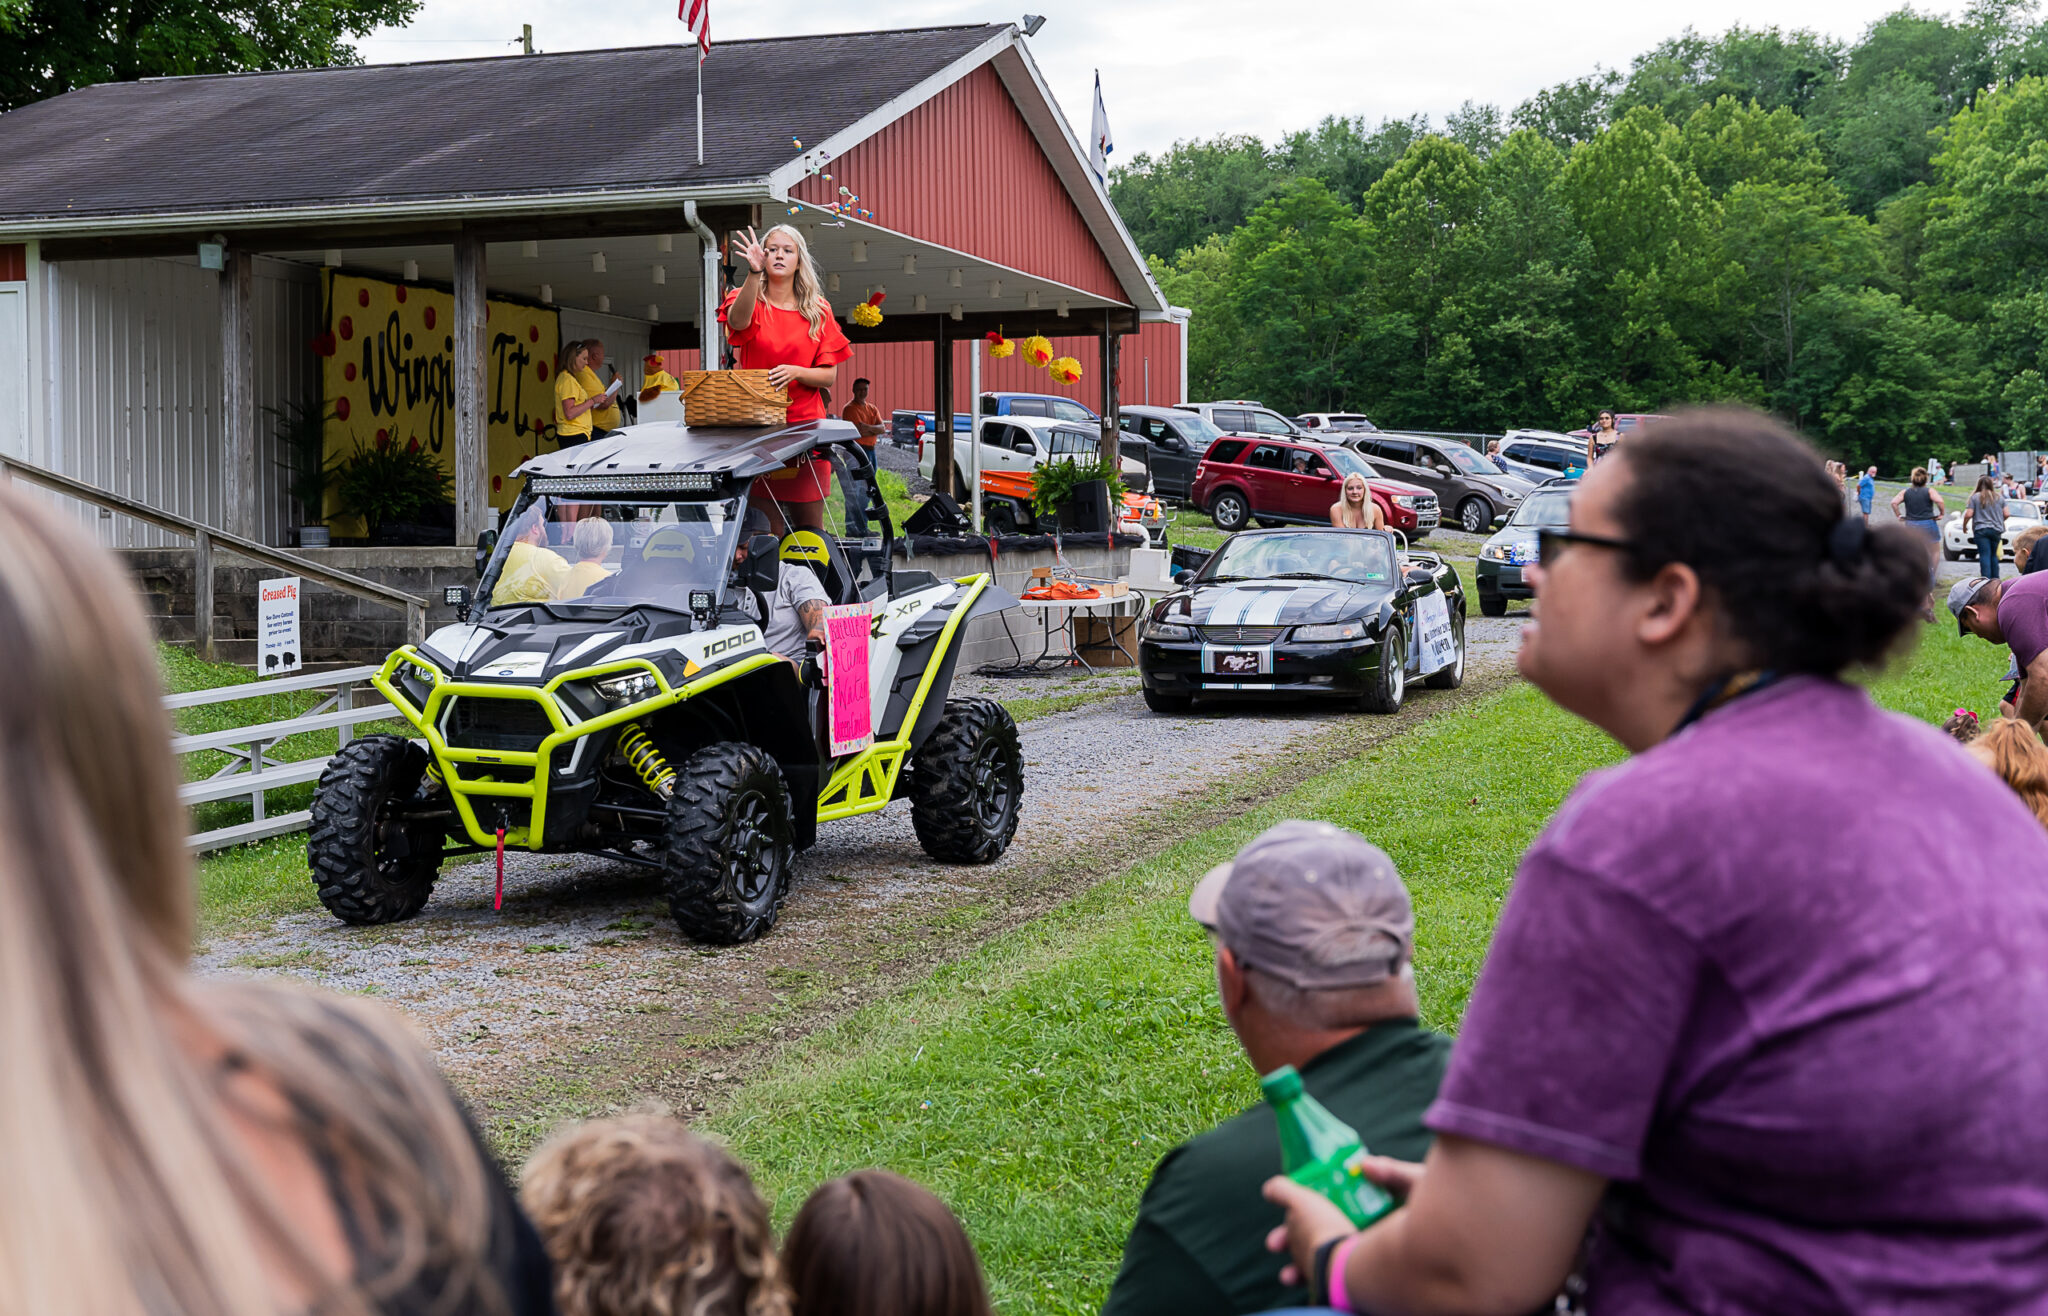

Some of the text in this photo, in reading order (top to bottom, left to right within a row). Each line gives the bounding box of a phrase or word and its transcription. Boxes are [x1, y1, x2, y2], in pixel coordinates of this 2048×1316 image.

[488, 332, 530, 437] It
[262, 585, 297, 602] Greased Pig
[895, 600, 922, 620] XP
[703, 630, 756, 659] 1000
